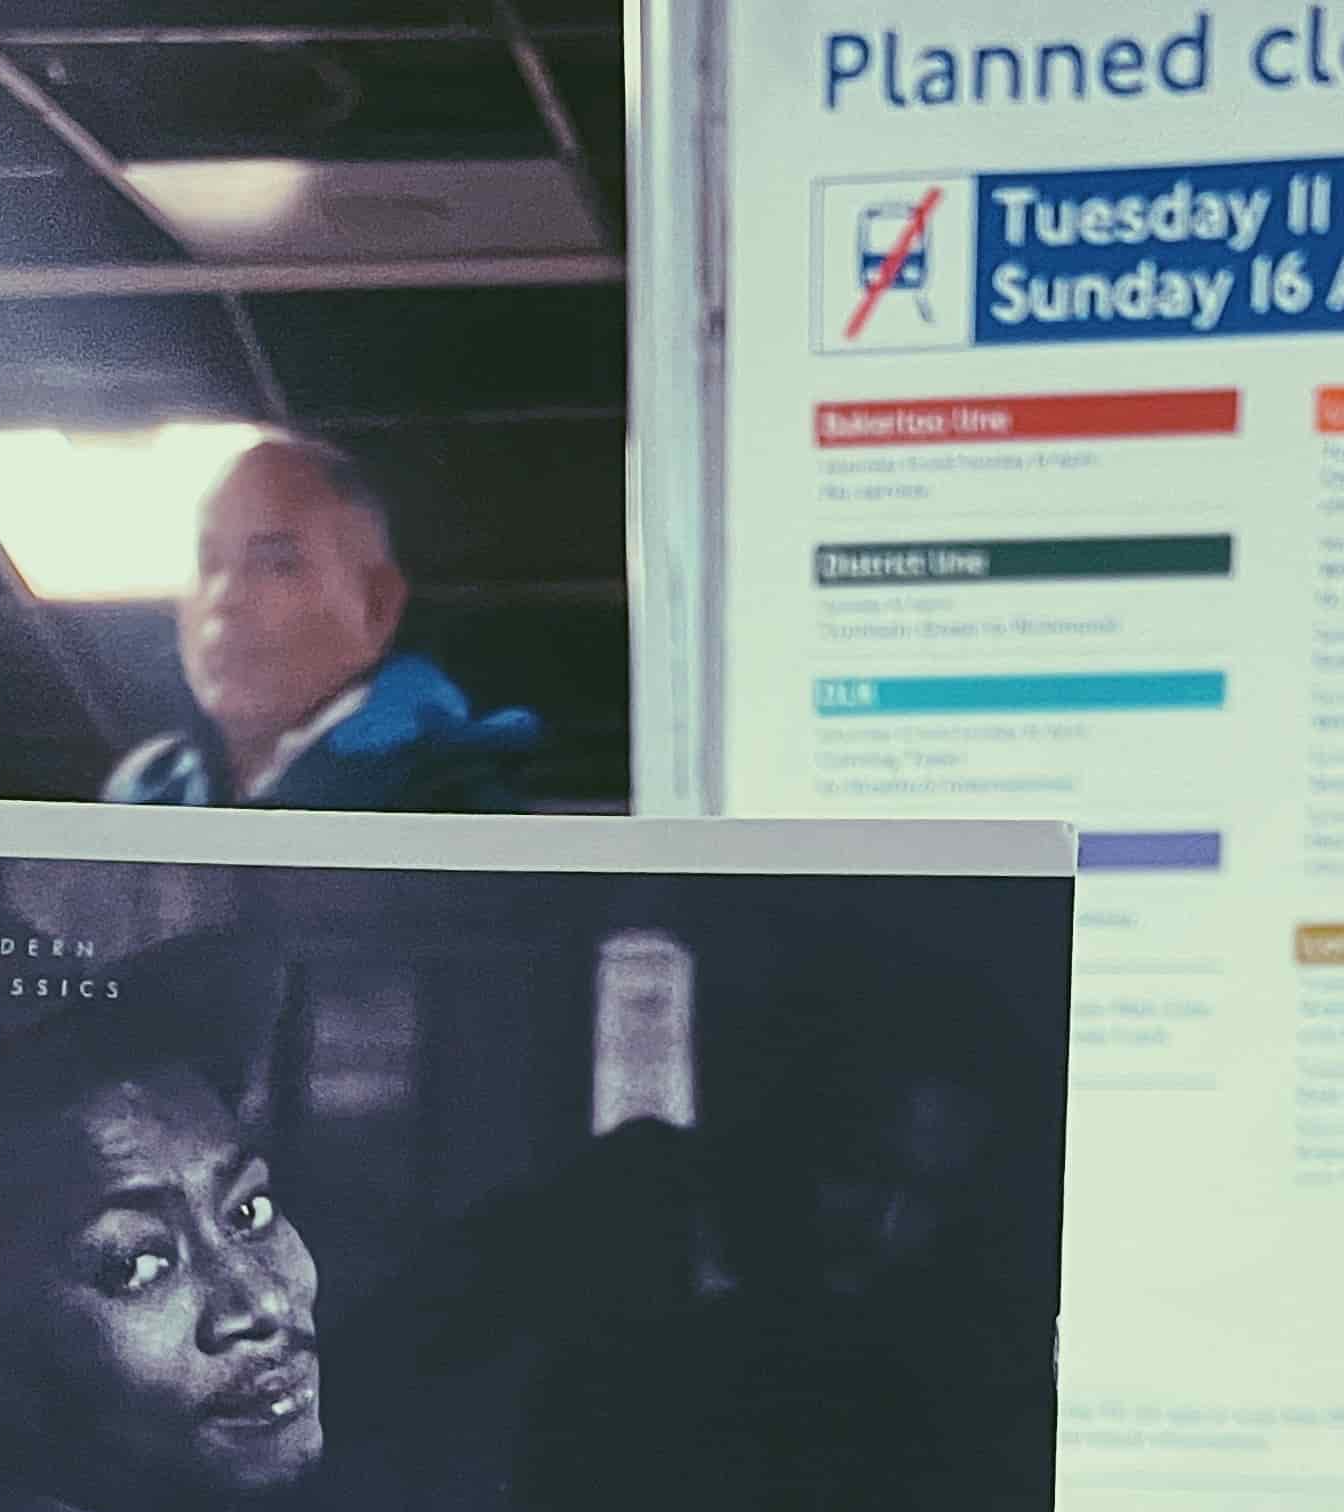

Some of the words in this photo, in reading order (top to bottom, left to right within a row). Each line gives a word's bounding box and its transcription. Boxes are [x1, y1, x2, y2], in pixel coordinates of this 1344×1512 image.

[821, 12, 1210, 110] Planned
[992, 180, 1280, 249] Tuesday
[1287, 173, 1333, 235] 11
[990, 258, 1231, 331] Sunday
[1253, 257, 1311, 312] 16
